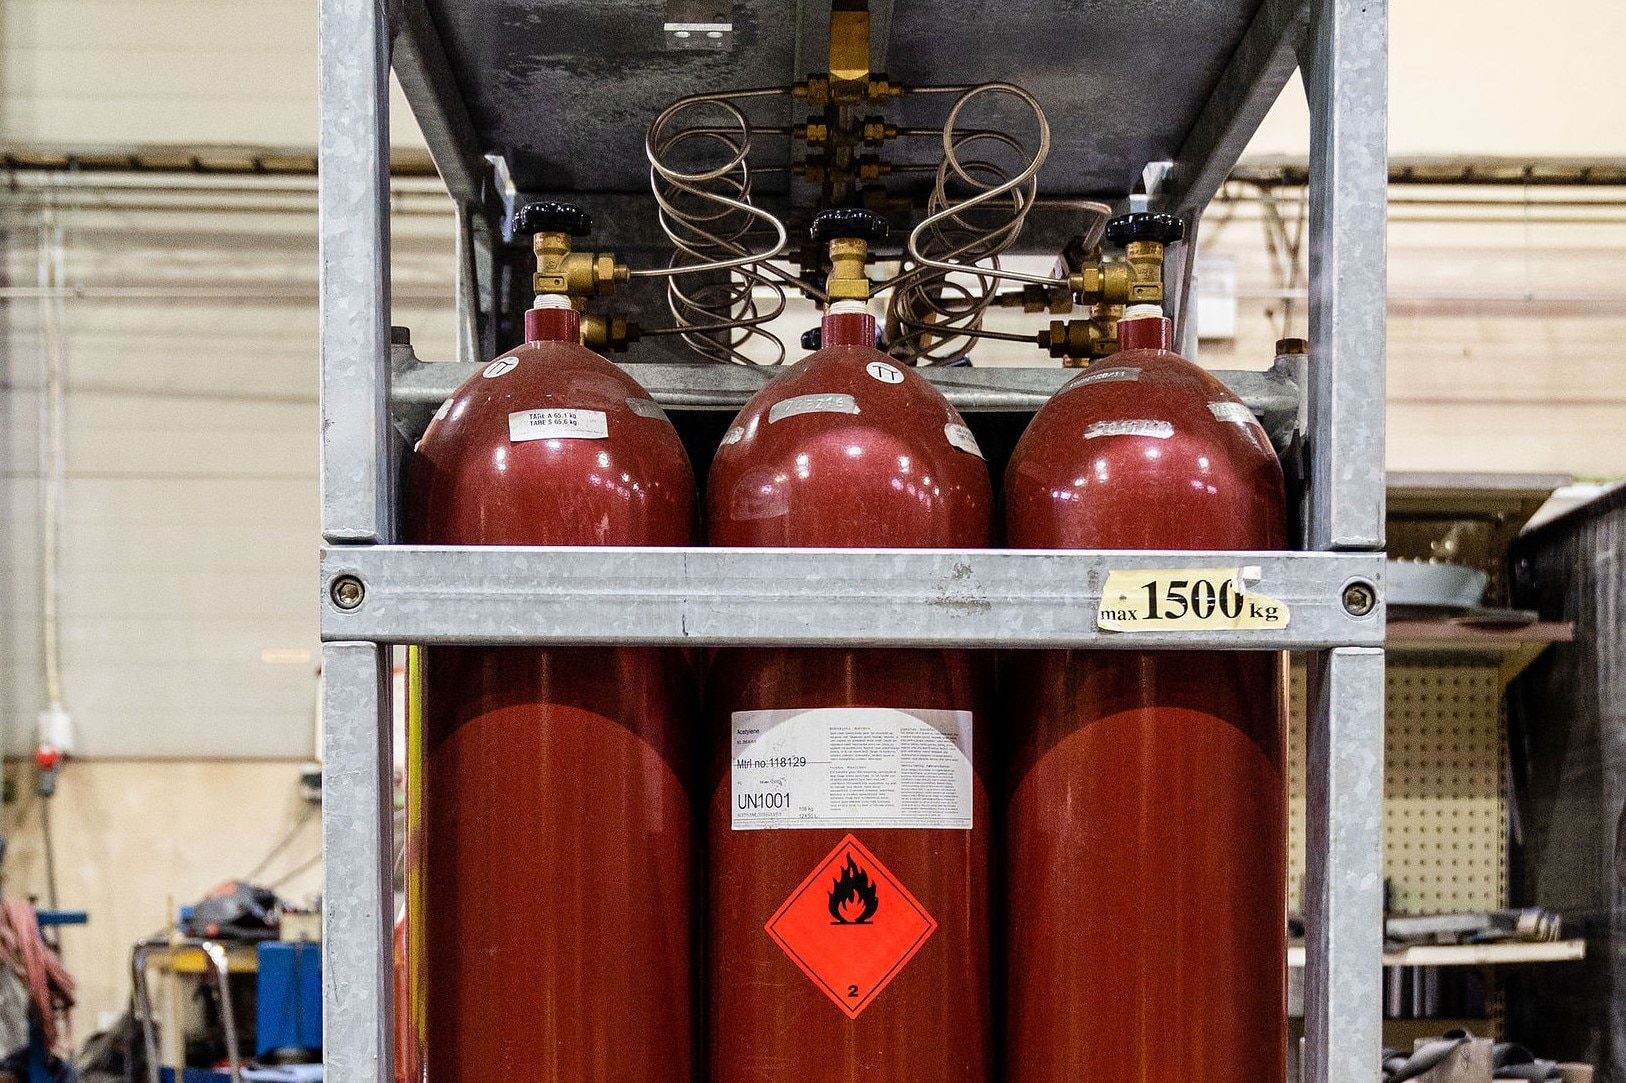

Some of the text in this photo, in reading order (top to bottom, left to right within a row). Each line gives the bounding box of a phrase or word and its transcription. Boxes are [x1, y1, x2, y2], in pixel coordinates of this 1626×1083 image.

[871, 365, 898, 381] TT
[1101, 579, 1279, 622] max 1500 kg
[737, 759, 752, 769] Mtrl
[738, 792, 790, 810] UN1001
[848, 984, 859, 997] 2
